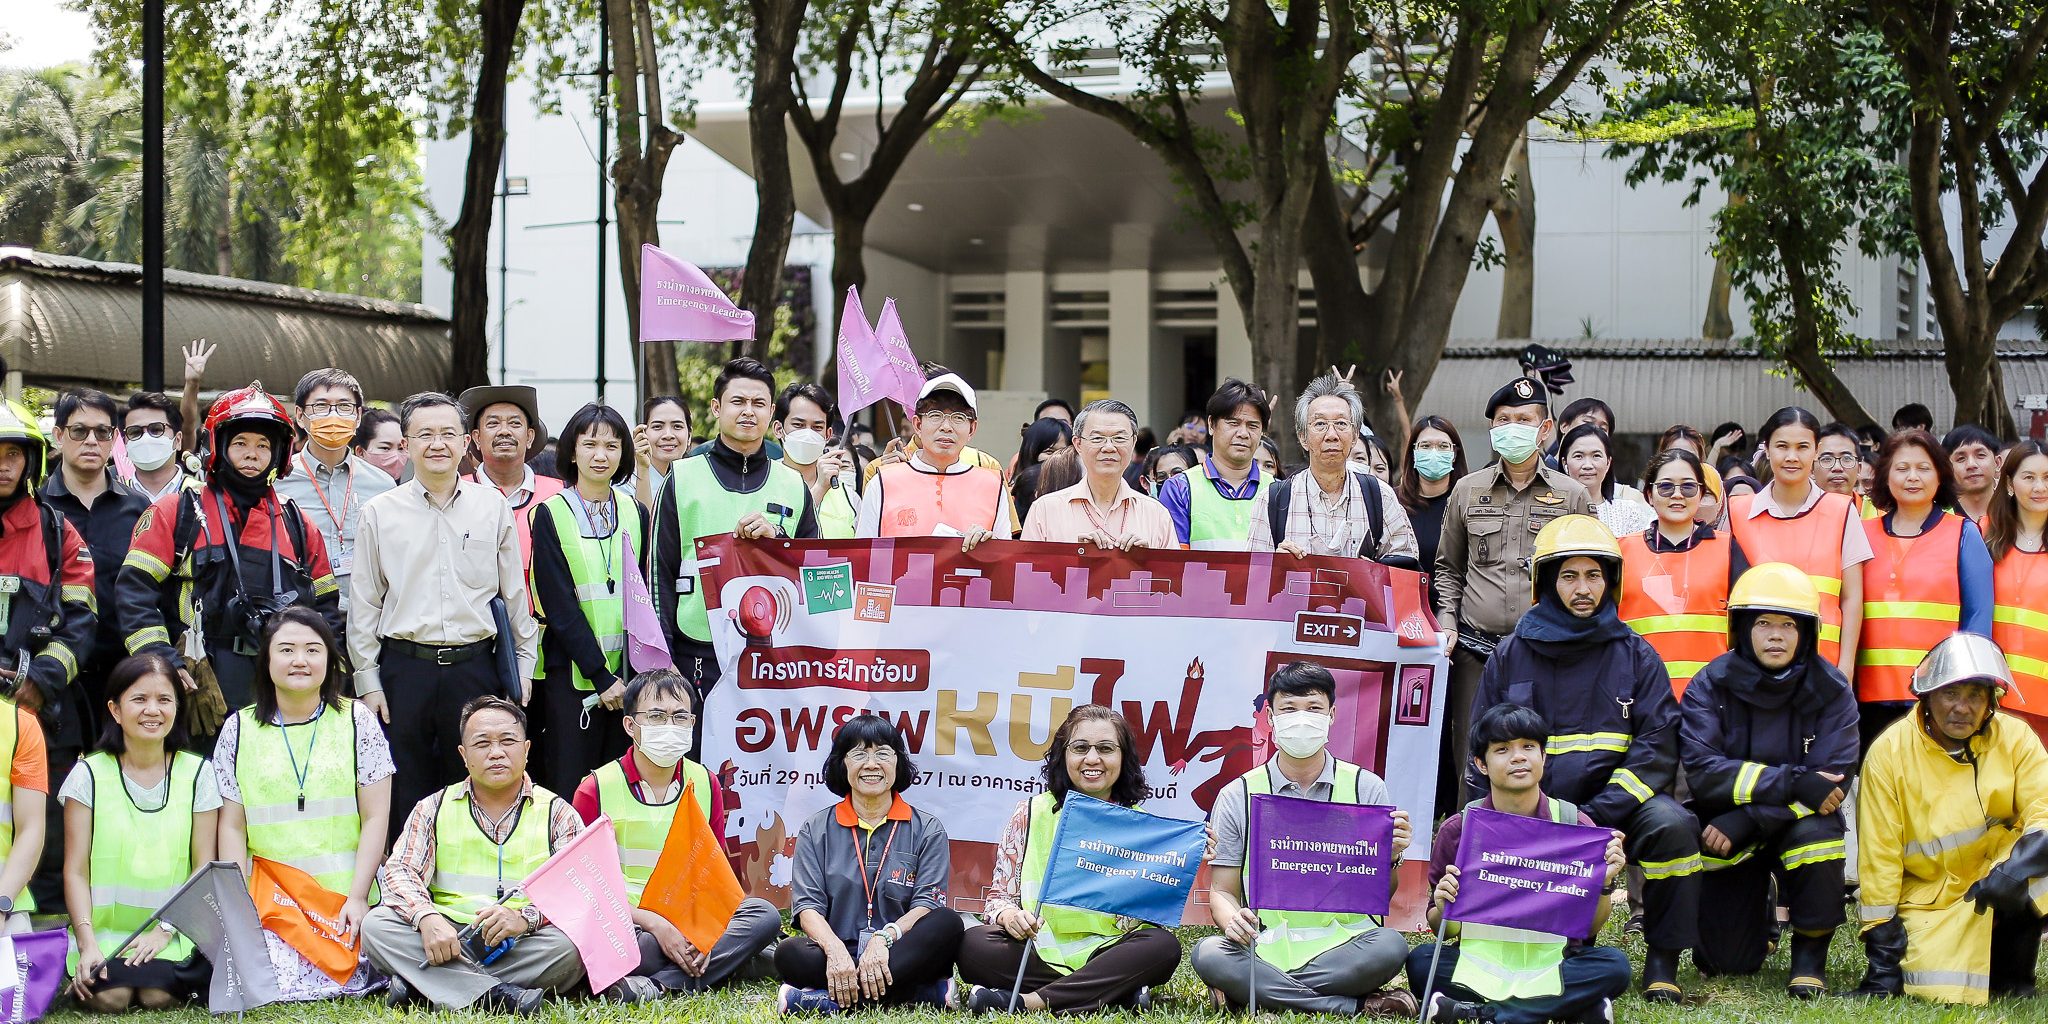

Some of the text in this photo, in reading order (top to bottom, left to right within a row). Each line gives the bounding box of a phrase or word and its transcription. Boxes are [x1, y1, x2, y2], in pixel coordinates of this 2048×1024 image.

[656, 295, 746, 319] Emergency Leader
[807, 571, 814, 582] 3
[859, 586, 866, 596] 11
[1302, 622, 1340, 638] EXIT
[750, 651, 918, 684] โครงการฝึกซ้อม
[739, 763, 772, 787] วันที่
[775, 770, 800, 785] 29
[948, 774, 966, 787] ณ
[1079, 839, 1187, 869] ธงนำทางอพยพหนีไฟ
[1270, 835, 1378, 857] ธงนำทางอพยพหนีไฟ
[1075, 856, 1181, 887] Emergency Leader
[1270, 858, 1378, 876] Emergency Leader
[1480, 850, 1594, 879] ธงนำทางอพยพหนีไฟ
[1477, 868, 1590, 899] Emergency Leader
[564, 866, 629, 960] Emergency Leader
[224, 956, 236, 998] Leader
